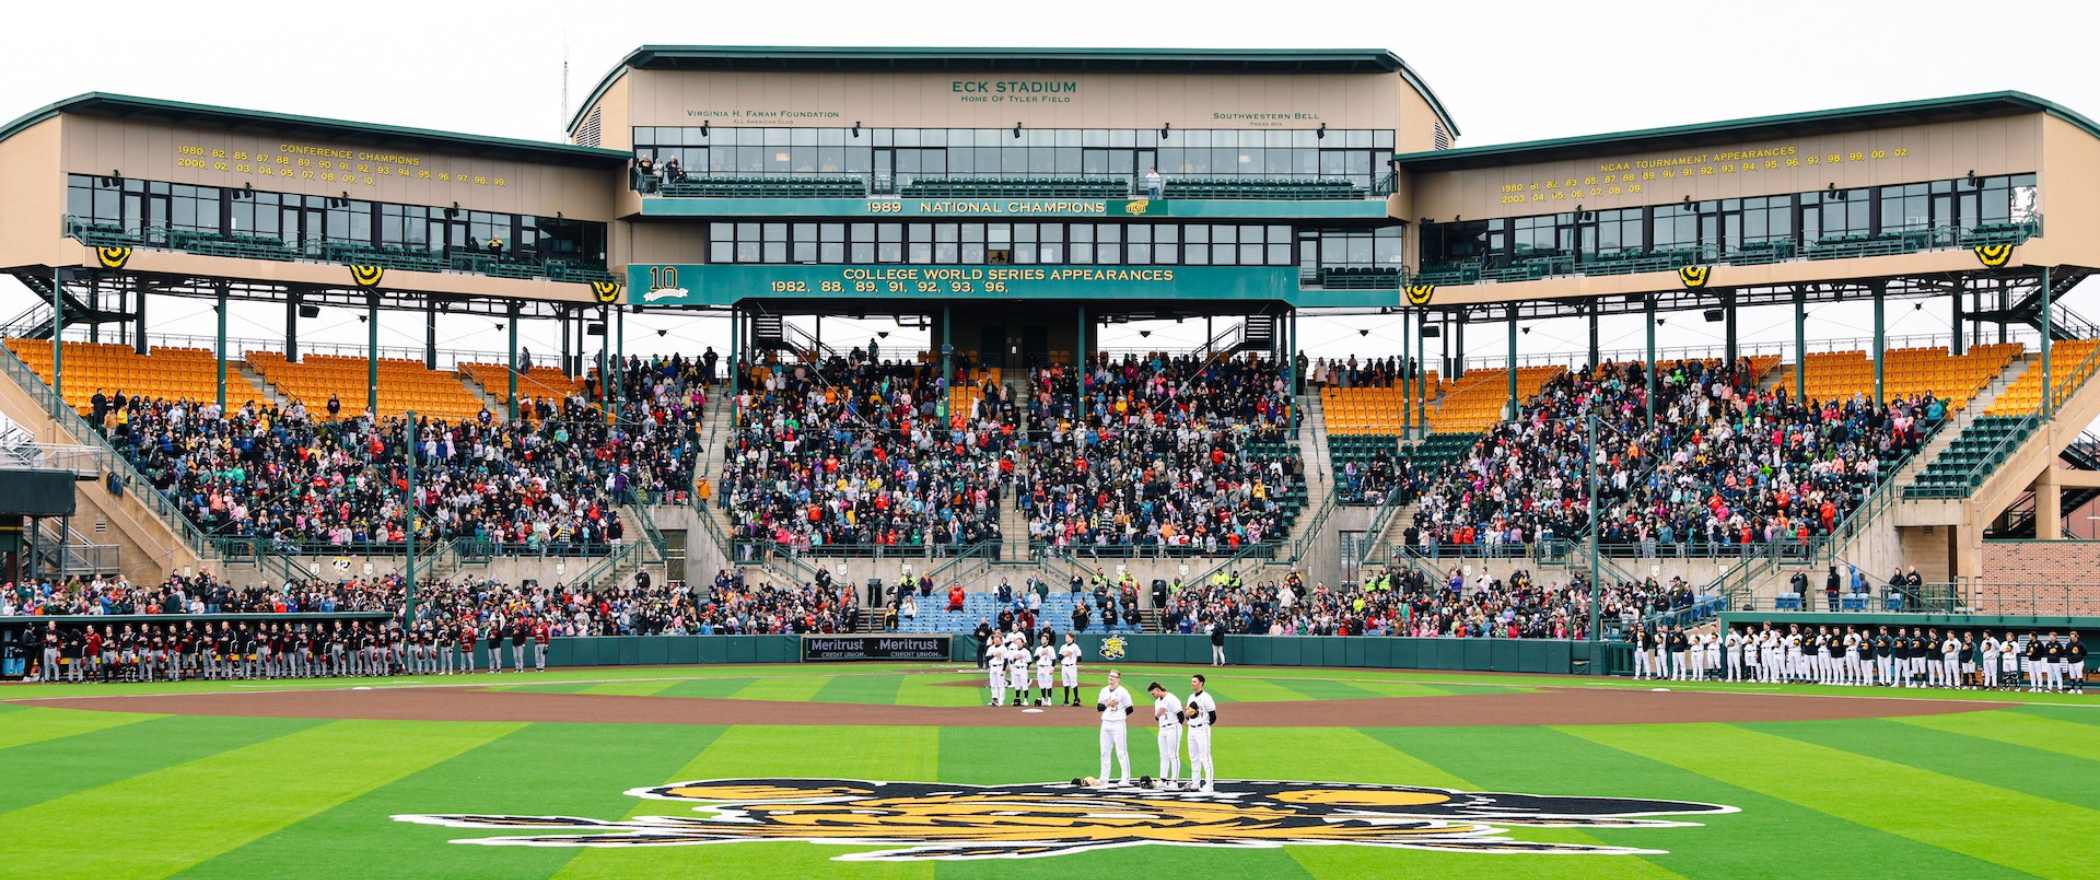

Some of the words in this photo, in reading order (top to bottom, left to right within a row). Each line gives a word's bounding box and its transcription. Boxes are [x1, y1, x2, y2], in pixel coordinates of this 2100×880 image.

[952, 81, 989, 92] ECK
[996, 81, 1076, 92] STADIUM
[280, 144, 353, 159] CONFERENCE
[358, 152, 420, 166] CHAMPIONS
[1601, 161, 1631, 173] NCAA
[1635, 154, 1708, 171] TOURNAMENT
[1713, 146, 1796, 162] APPEARANCES
[866, 202, 902, 213] 1989
[920, 202, 1003, 213] NATIONAL
[1007, 202, 1106, 213] CHAMPIONS
[650, 266, 678, 290] 10
[843, 269, 919, 280] COLLEGE
[923, 269, 984, 280] WORLD
[988, 269, 1045, 280] SERIES
[1050, 270, 1174, 281] APPEARANCES
[771, 281, 811, 293] 1982,
[335, 560, 349, 572] 42
[811, 639, 864, 650] Meritrust
[880, 639, 938, 650] Meritrust
